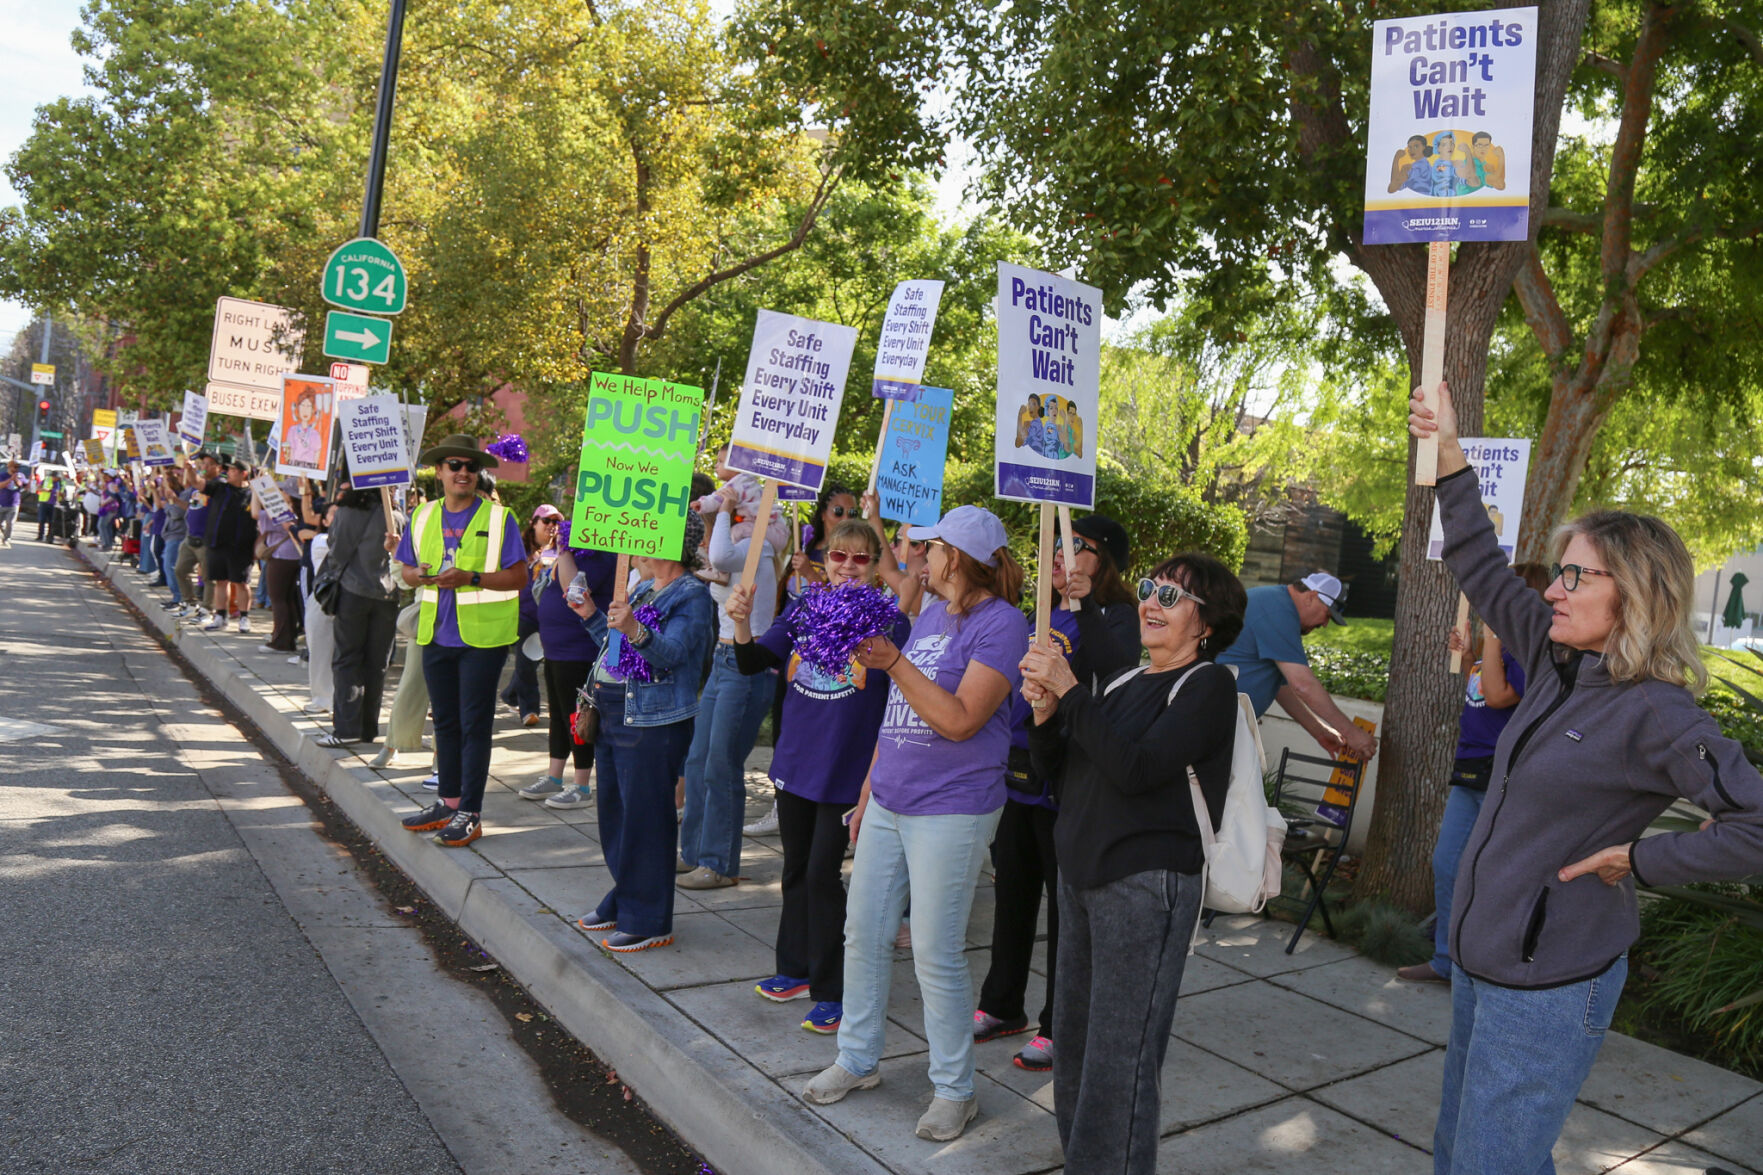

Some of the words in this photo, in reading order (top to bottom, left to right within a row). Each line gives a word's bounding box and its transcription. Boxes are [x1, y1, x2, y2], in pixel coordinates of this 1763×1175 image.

[1385, 19, 1523, 56] Patients
[1410, 52, 1494, 86] Can't
[1413, 86, 1486, 120] Wait
[341, 253, 396, 272] CALIFORNIA
[336, 265, 396, 306] 134
[904, 288, 924, 300] Safe
[894, 304, 927, 320] Staffing
[1012, 276, 1092, 326] Patients
[224, 312, 260, 327] RIGHT
[886, 320, 908, 335] Every
[908, 320, 930, 334] Shift
[230, 335, 279, 354] MUS
[788, 329, 822, 352] Safe
[884, 336, 906, 352] Every
[906, 336, 924, 350] Unit
[1029, 314, 1078, 354] Can't
[218, 358, 250, 372] TURN
[332, 366, 347, 378] NO
[769, 348, 830, 380] Staffing
[882, 352, 918, 370] Everyday
[1032, 348, 1075, 386] Wait
[593, 375, 617, 392] We
[624, 380, 658, 404] Help
[662, 385, 700, 407] Moms
[754, 367, 798, 394] Every
[800, 378, 835, 400] Shift
[212, 392, 246, 408] BUSES
[250, 397, 280, 412] EXEM
[358, 404, 379, 415] Safe
[752, 389, 796, 417] Every
[798, 400, 828, 422] Unit
[914, 402, 946, 424] YOUR
[352, 416, 390, 428] Staffing
[587, 397, 699, 444] PUSH
[751, 412, 820, 446] Everyday
[892, 418, 936, 440] CERVIX
[348, 430, 374, 440] Every
[376, 426, 398, 438] Shift
[352, 442, 378, 452] Every
[379, 438, 398, 449] Unit
[1462, 444, 1520, 462] atients
[356, 452, 398, 464] Everyday
[606, 457, 634, 472] Now
[638, 461, 659, 475] We
[892, 460, 918, 480] ASK
[1472, 462, 1503, 478] an't
[577, 470, 689, 518] PUSH
[878, 475, 939, 500] MANAGEMENT
[585, 506, 612, 524] For
[618, 512, 659, 530] Safe
[886, 497, 916, 519] WHY
[578, 528, 664, 554] Staffing!
[804, 690, 829, 700] PATIENT
[884, 704, 928, 727] LIVE
